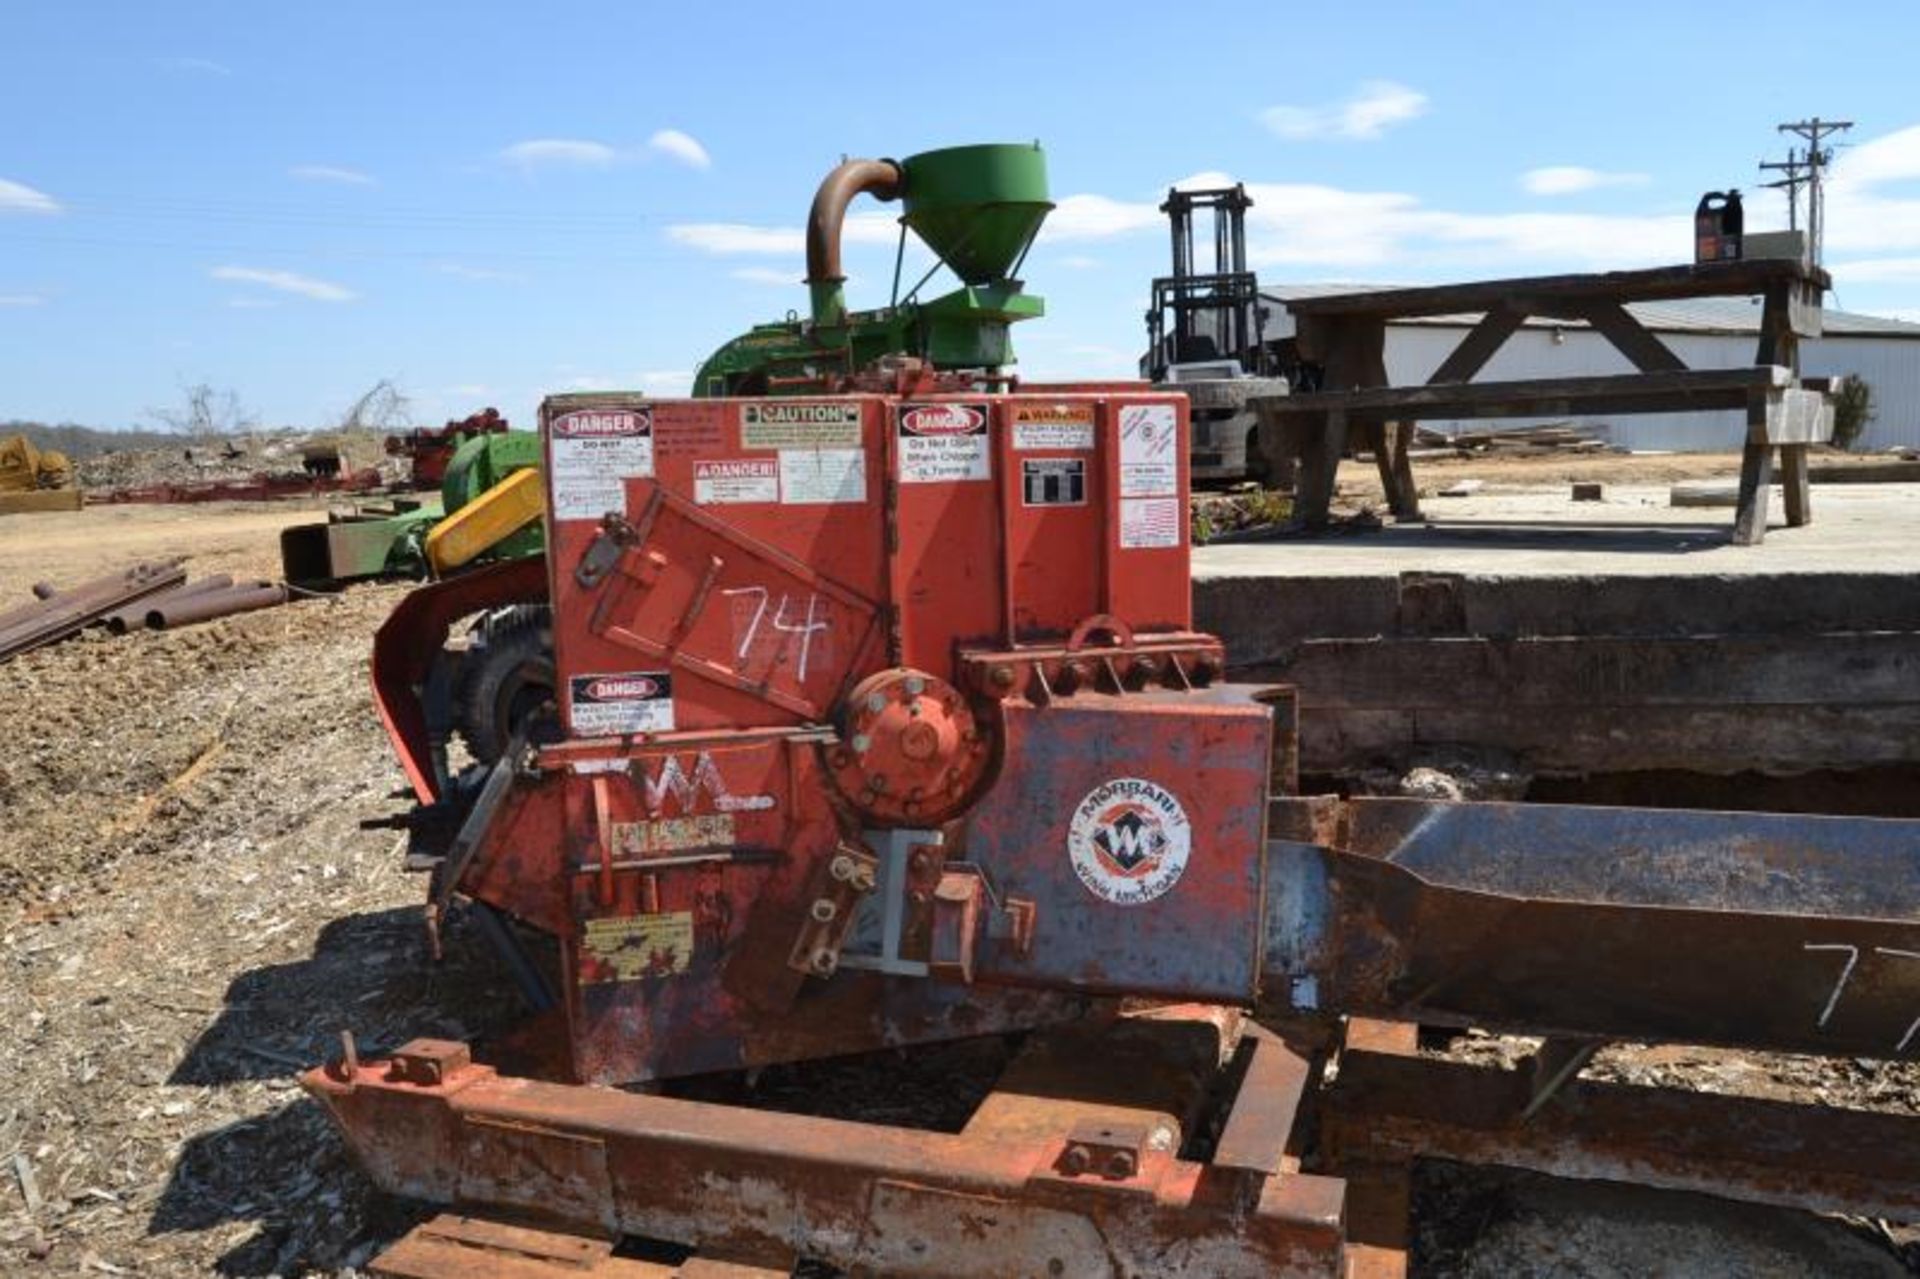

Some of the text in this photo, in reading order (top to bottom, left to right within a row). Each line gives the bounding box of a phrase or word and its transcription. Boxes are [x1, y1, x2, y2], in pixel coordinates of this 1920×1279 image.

[568, 414, 636, 432] DANGER
[721, 585, 827, 682] 74
[596, 681, 647, 697] DANGER
